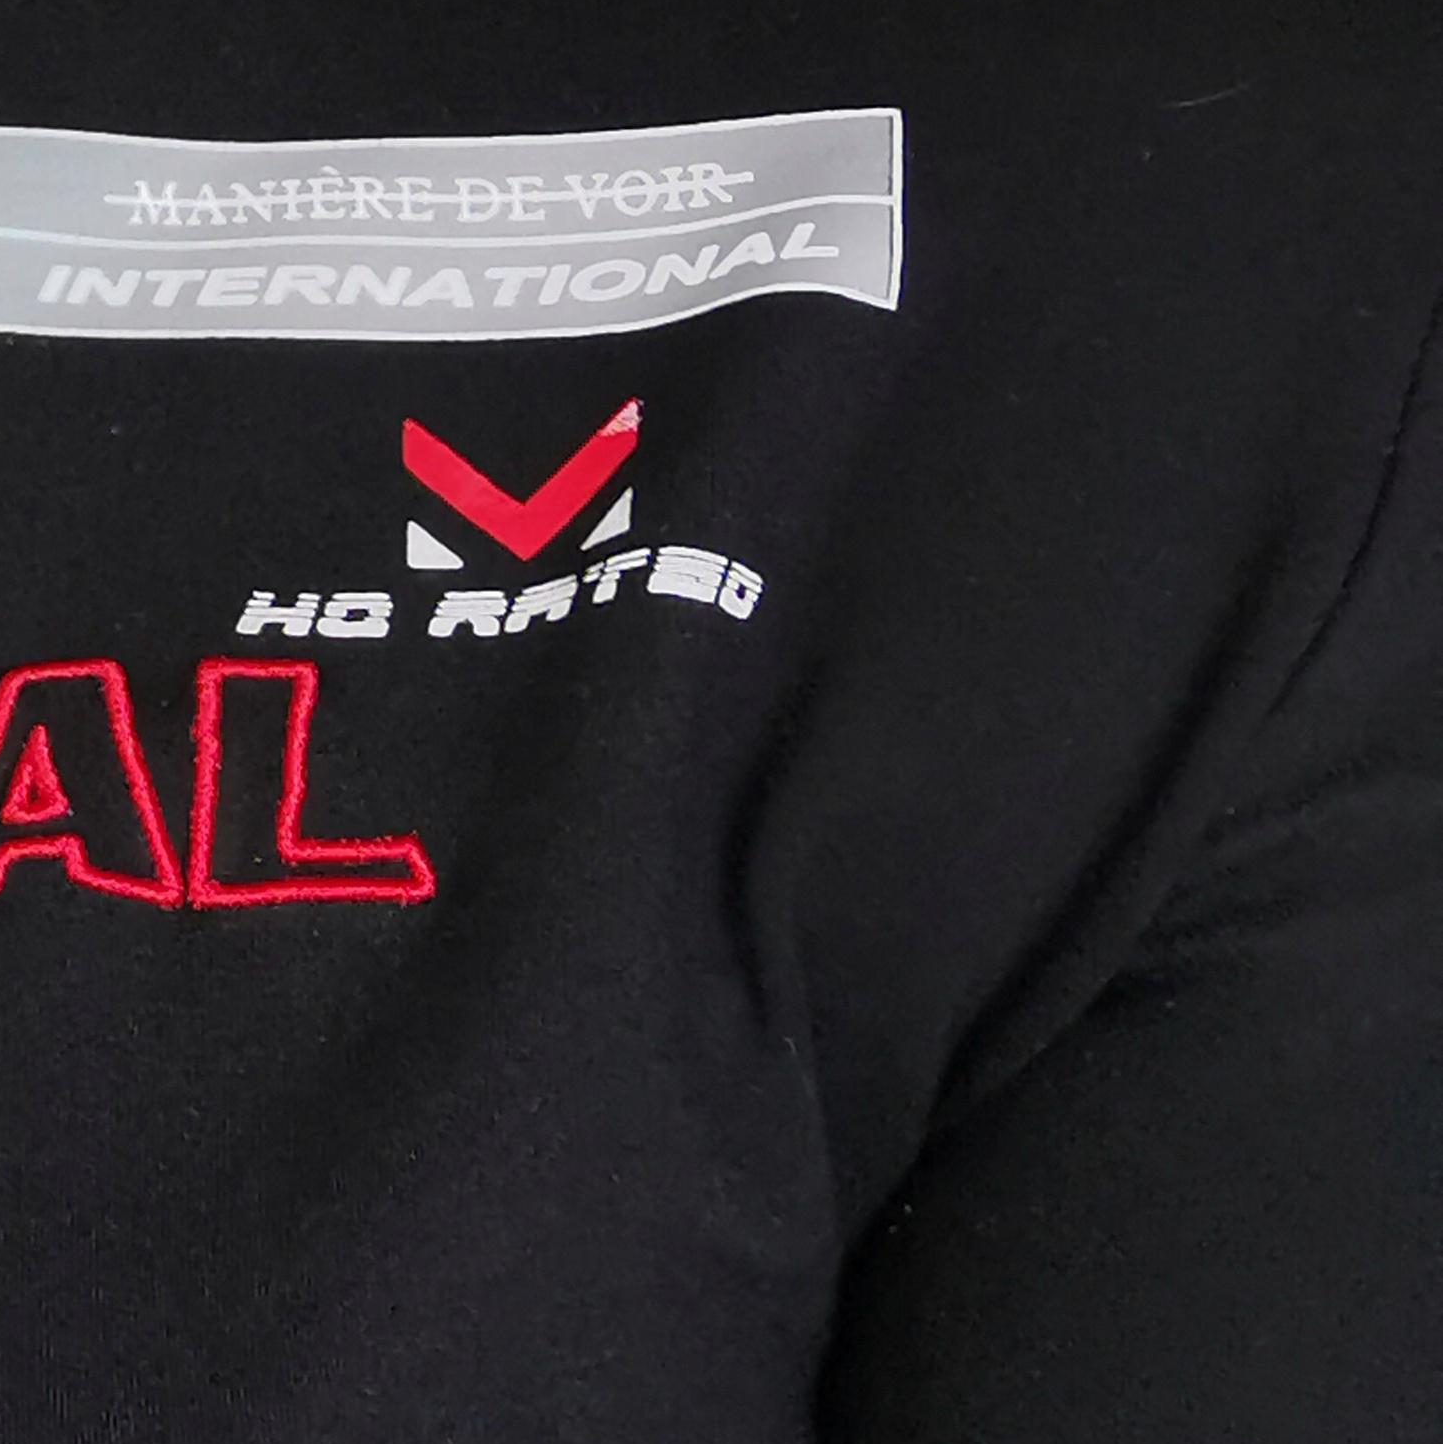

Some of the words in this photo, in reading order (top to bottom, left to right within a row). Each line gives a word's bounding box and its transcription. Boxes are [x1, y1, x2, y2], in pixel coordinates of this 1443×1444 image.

[455, 175, 547, 223] DE
[566, 162, 735, 218] VOIR
[37, 221, 842, 309] INTERNATIONAL
